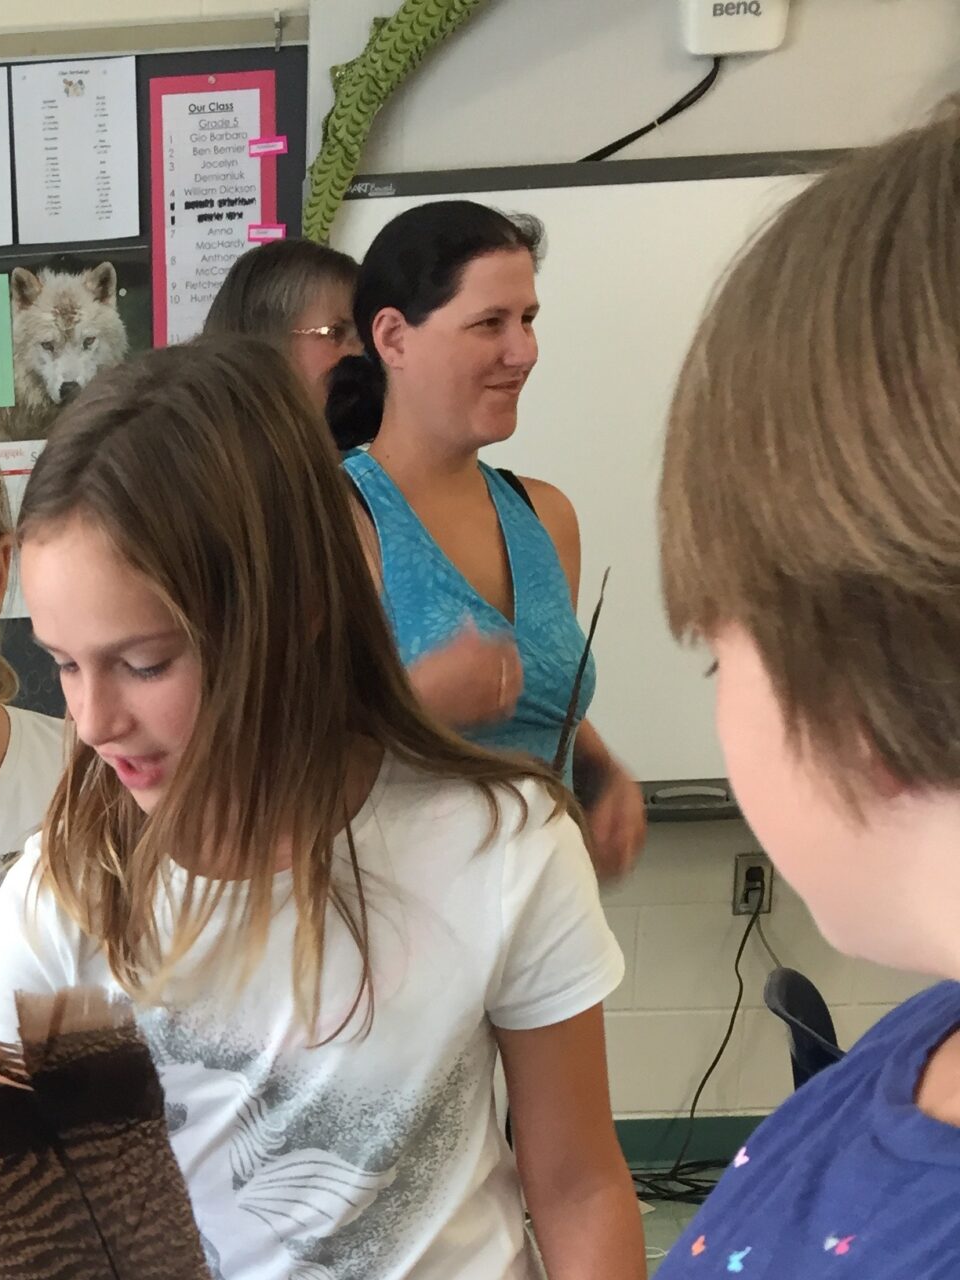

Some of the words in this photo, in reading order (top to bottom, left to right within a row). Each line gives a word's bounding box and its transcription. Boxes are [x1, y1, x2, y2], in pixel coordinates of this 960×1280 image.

[711, 0, 762, 17] BenQ
[188, 103, 206, 113] Our
[208, 102, 234, 112] Class
[199, 118, 231, 130] Grade
[192, 147, 211, 156] Ben
[200, 160, 239, 170] Jocelyn
[183, 186, 217, 197] William
[219, 183, 257, 195] Dickson
[207, 226, 234, 236] Anna
[195, 239, 246, 250] MacHardy
